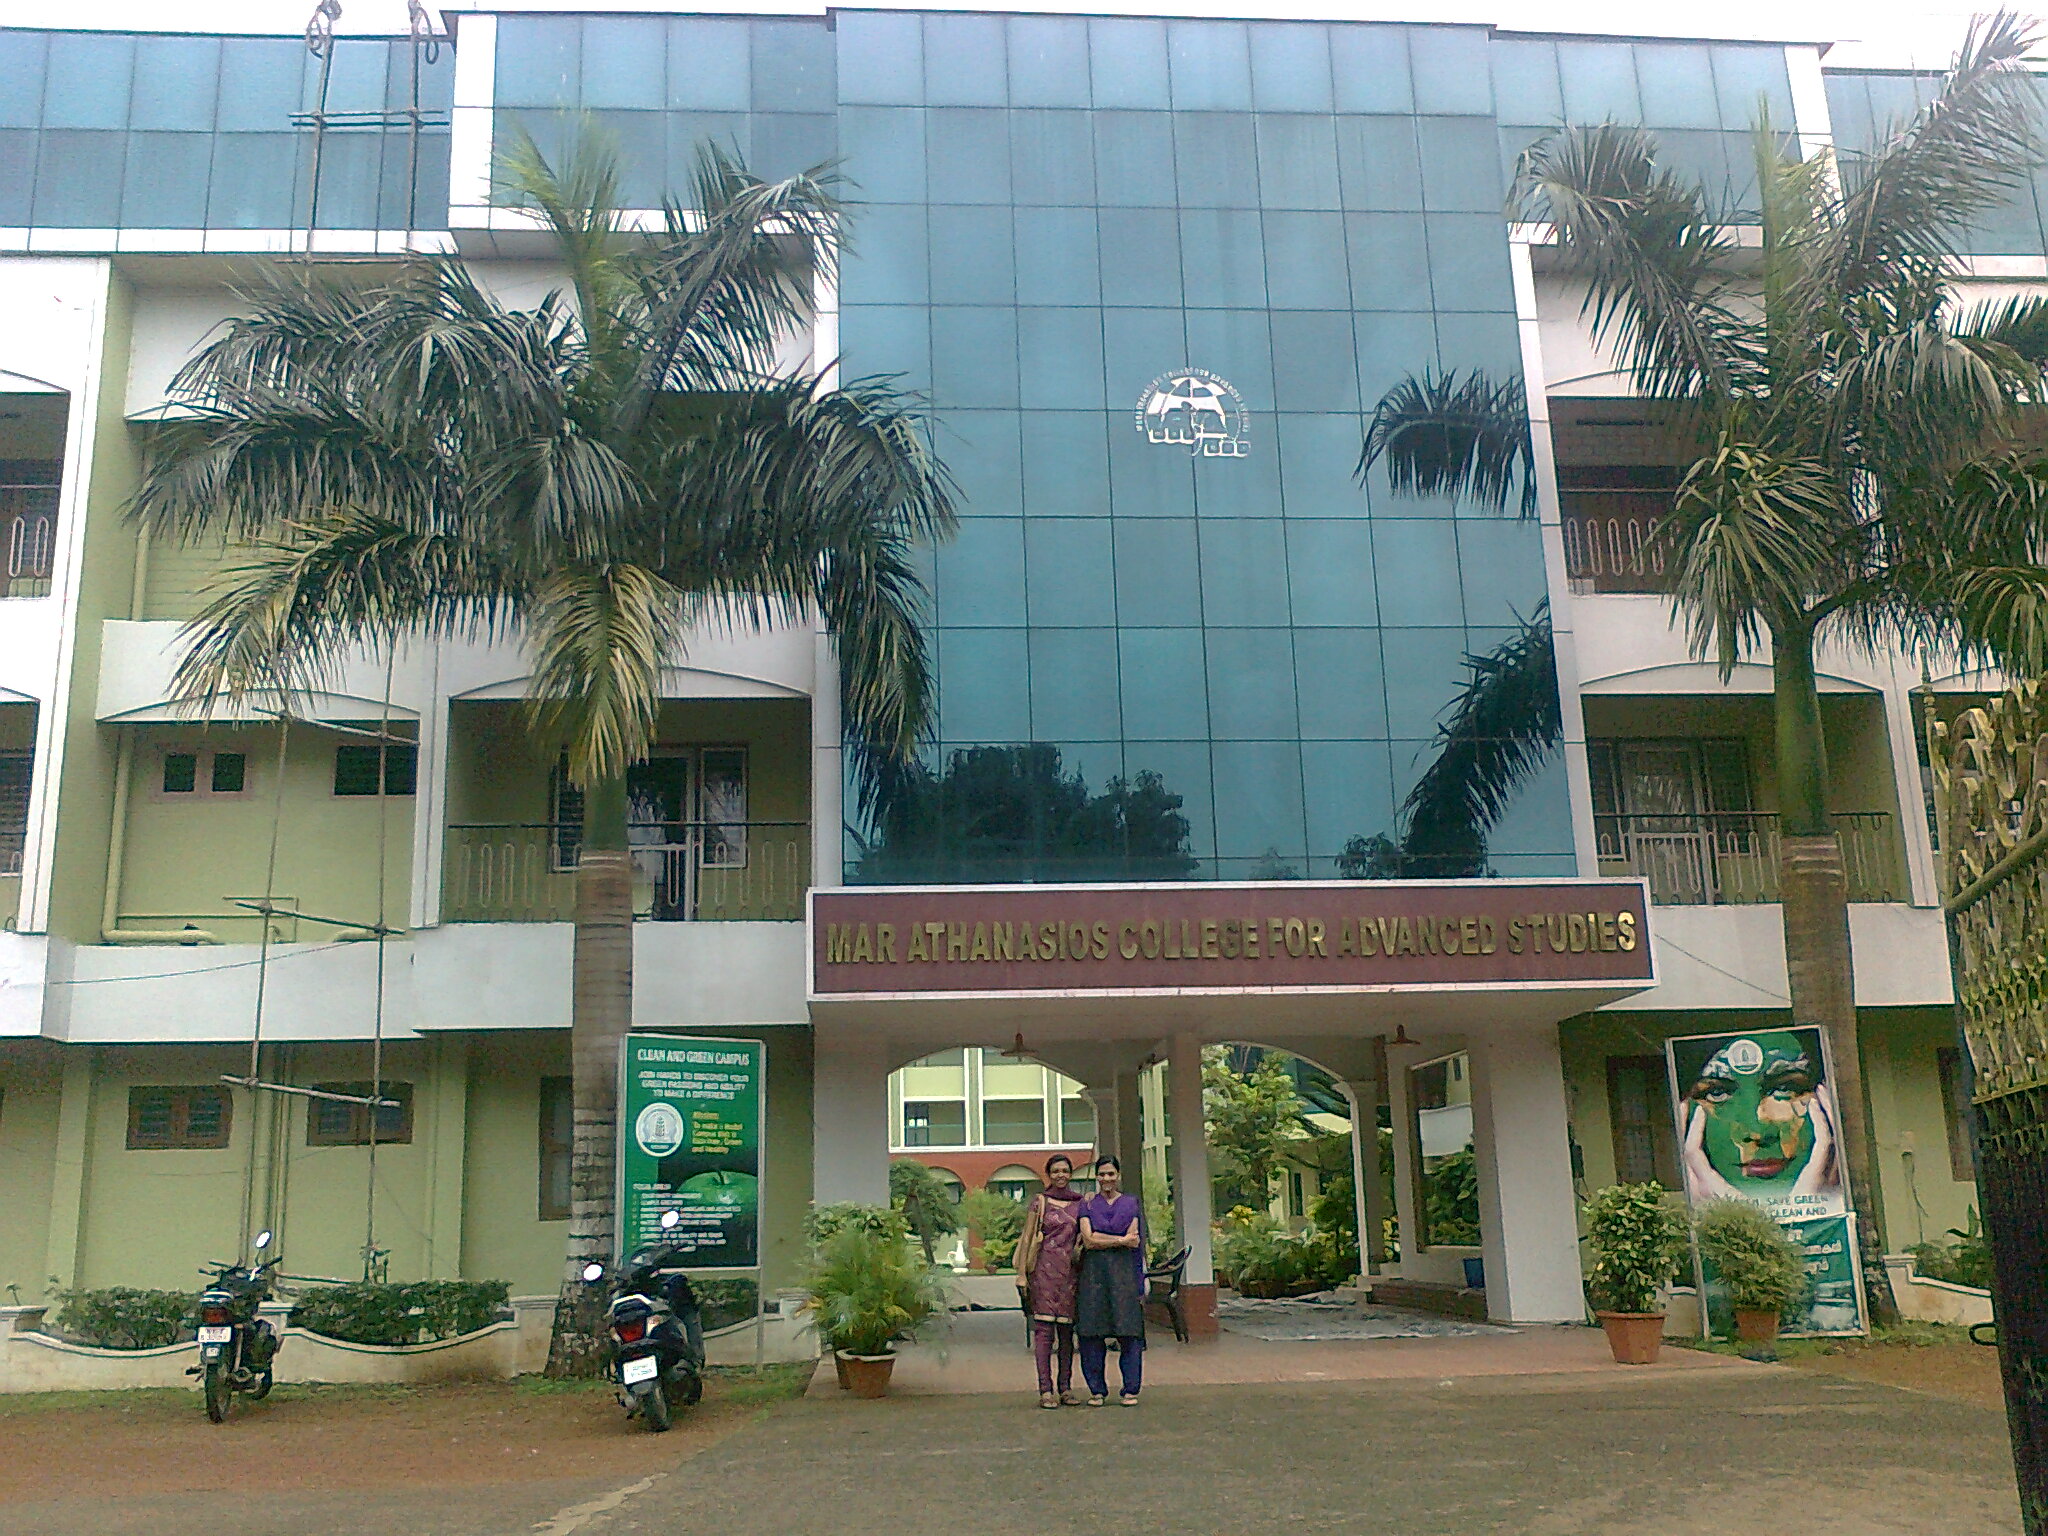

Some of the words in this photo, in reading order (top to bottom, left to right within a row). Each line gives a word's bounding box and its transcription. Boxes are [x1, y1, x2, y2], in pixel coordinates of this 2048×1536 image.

[826, 922, 897, 963] MAR
[907, 919, 1110, 963] ATHANASIOS
[1117, 917, 1259, 960] COLLEGE
[1266, 917, 1329, 959] FOR
[1337, 913, 1498, 958] ADVANCED
[1506, 910, 1637, 955] STUDIES
[637, 1048, 666, 1062] CLEAN
[666, 1049, 686, 1063] AND
[686, 1050, 715, 1064] GREEN
[715, 1052, 750, 1066] CAMPUS
[1794, 1194, 1829, 1206] GREEN
[1771, 1207, 1803, 1219] CLEAN
[1805, 1206, 1827, 1217] AND
